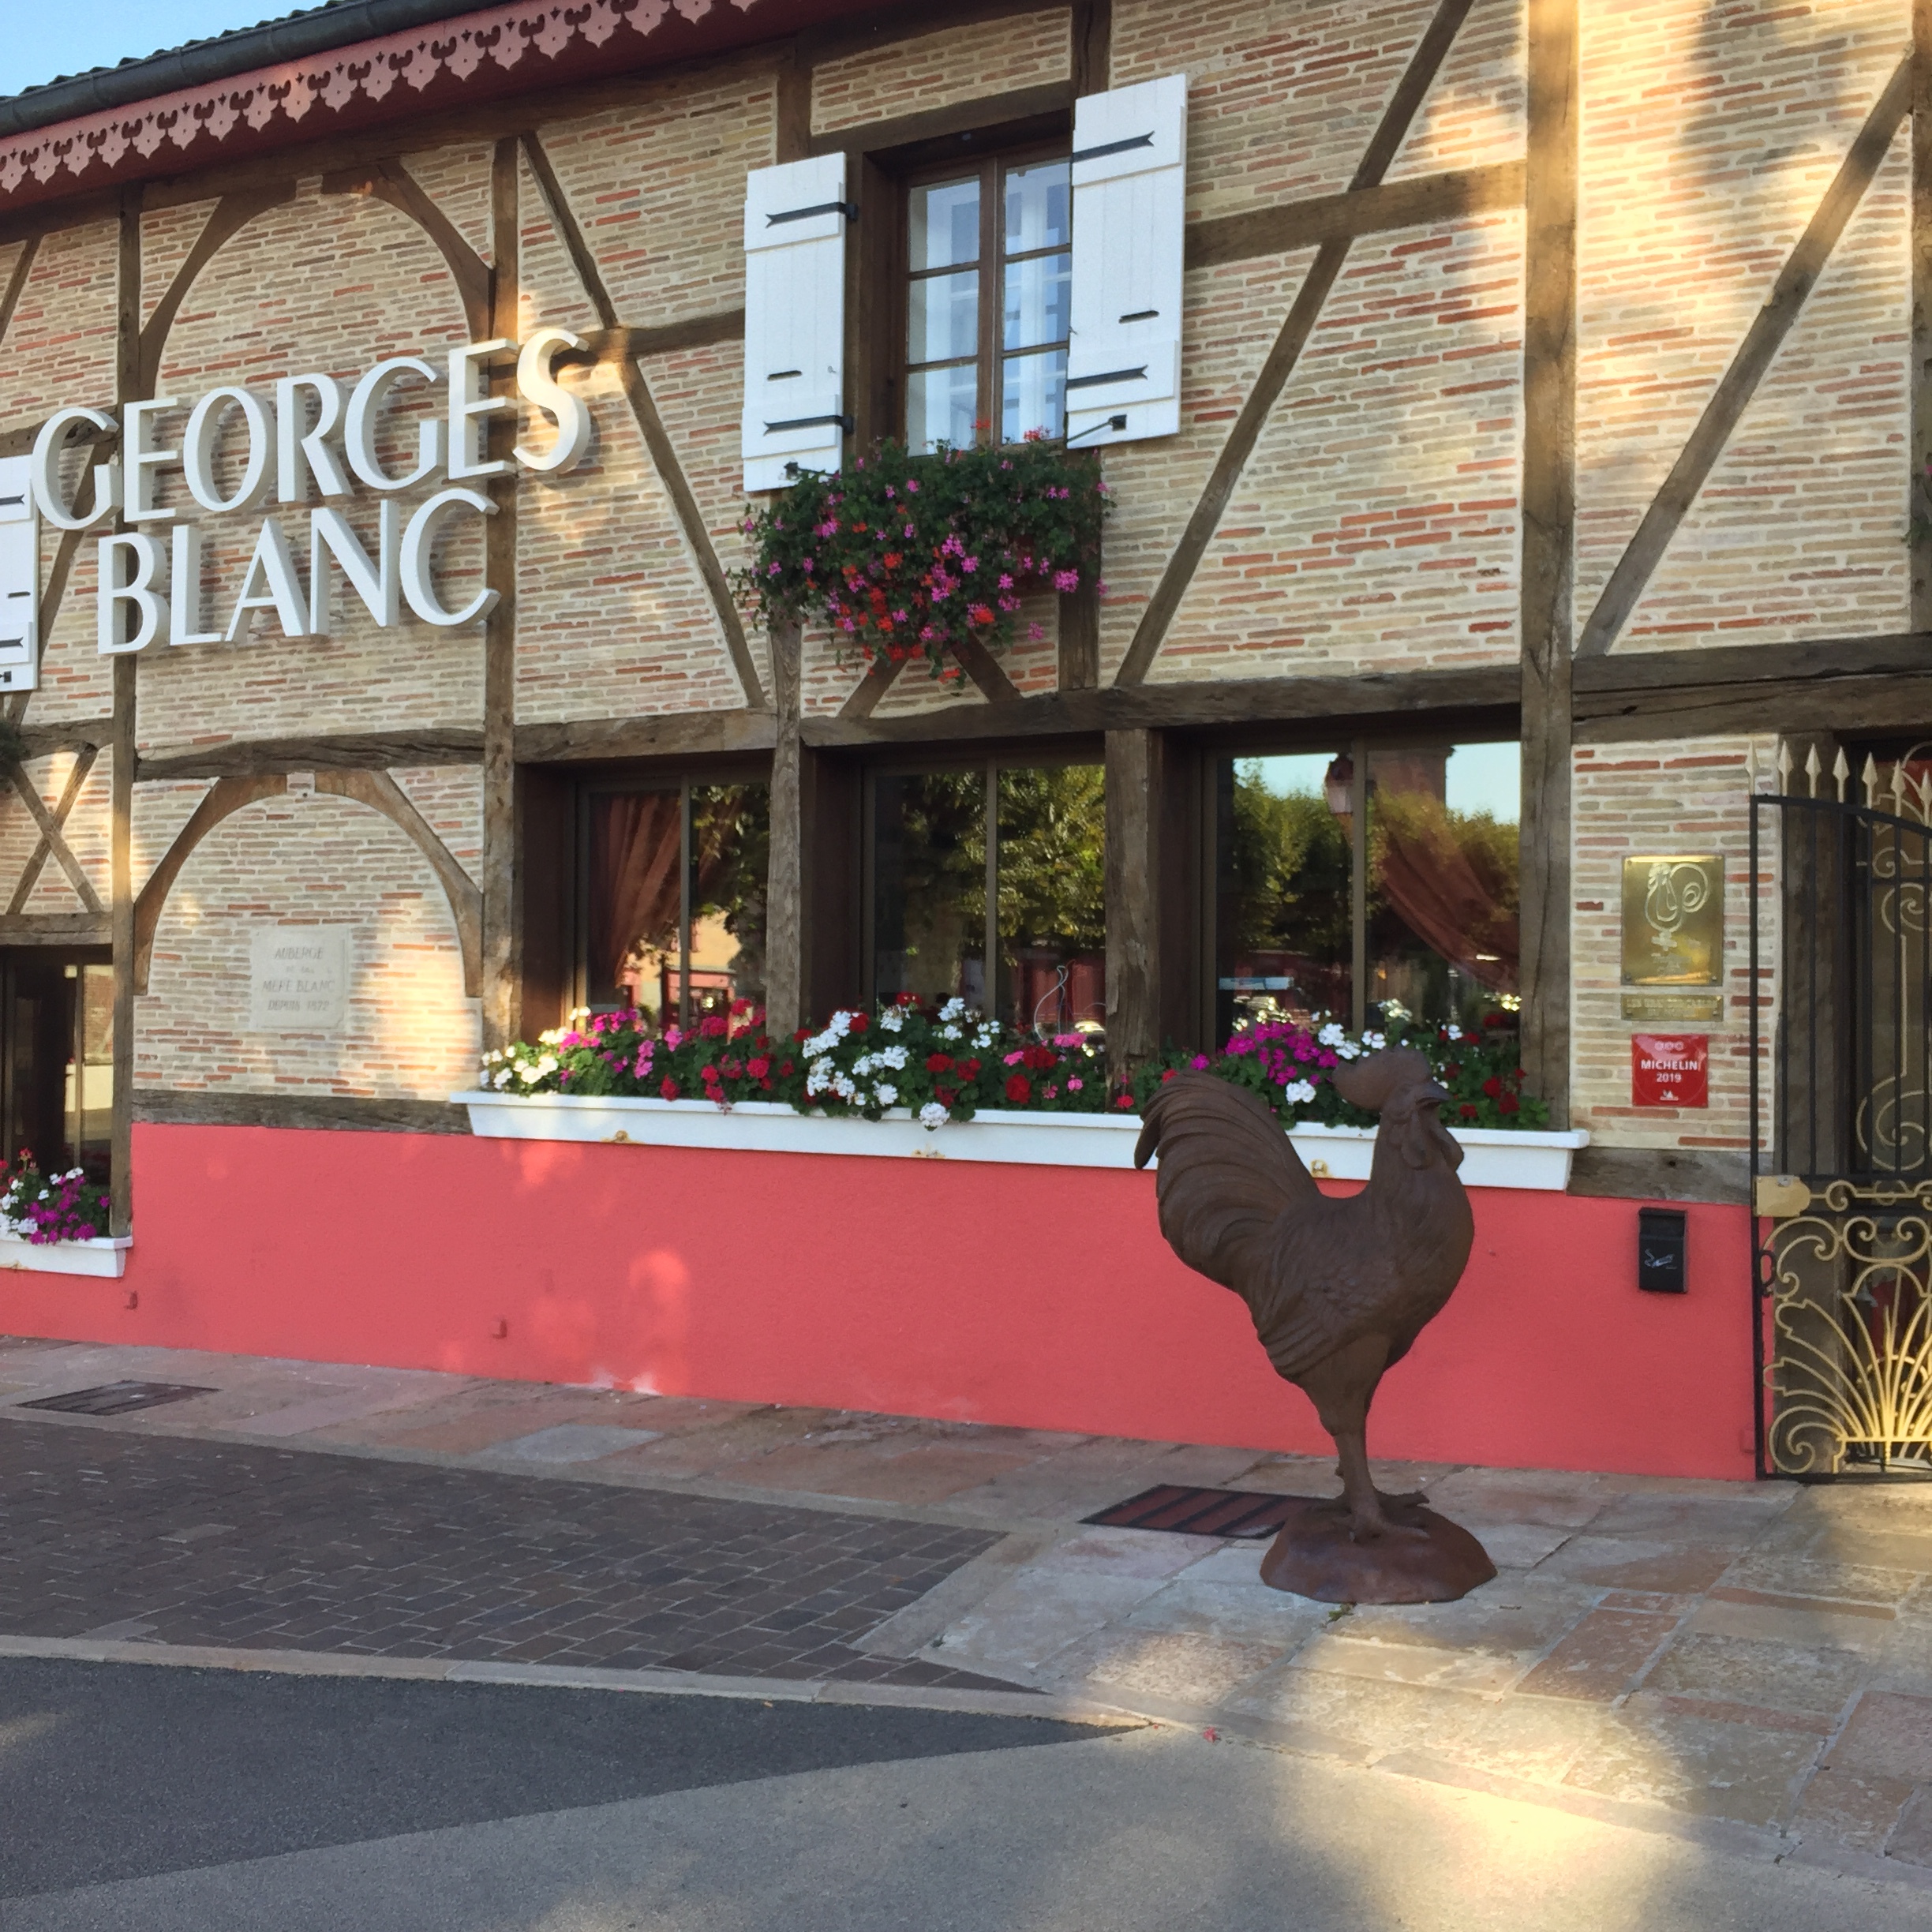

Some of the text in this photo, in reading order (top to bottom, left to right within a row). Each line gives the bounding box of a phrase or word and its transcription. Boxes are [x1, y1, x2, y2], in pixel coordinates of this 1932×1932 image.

[32, 328, 591, 530] GEORGES
[97, 488, 501, 654] BLANC
[274, 947, 324, 960] AUBERGE
[296, 979, 335, 993] BLANC
[1641, 1059, 1698, 1071] MICHELIN
[1656, 1073, 1683, 1084] 2019
